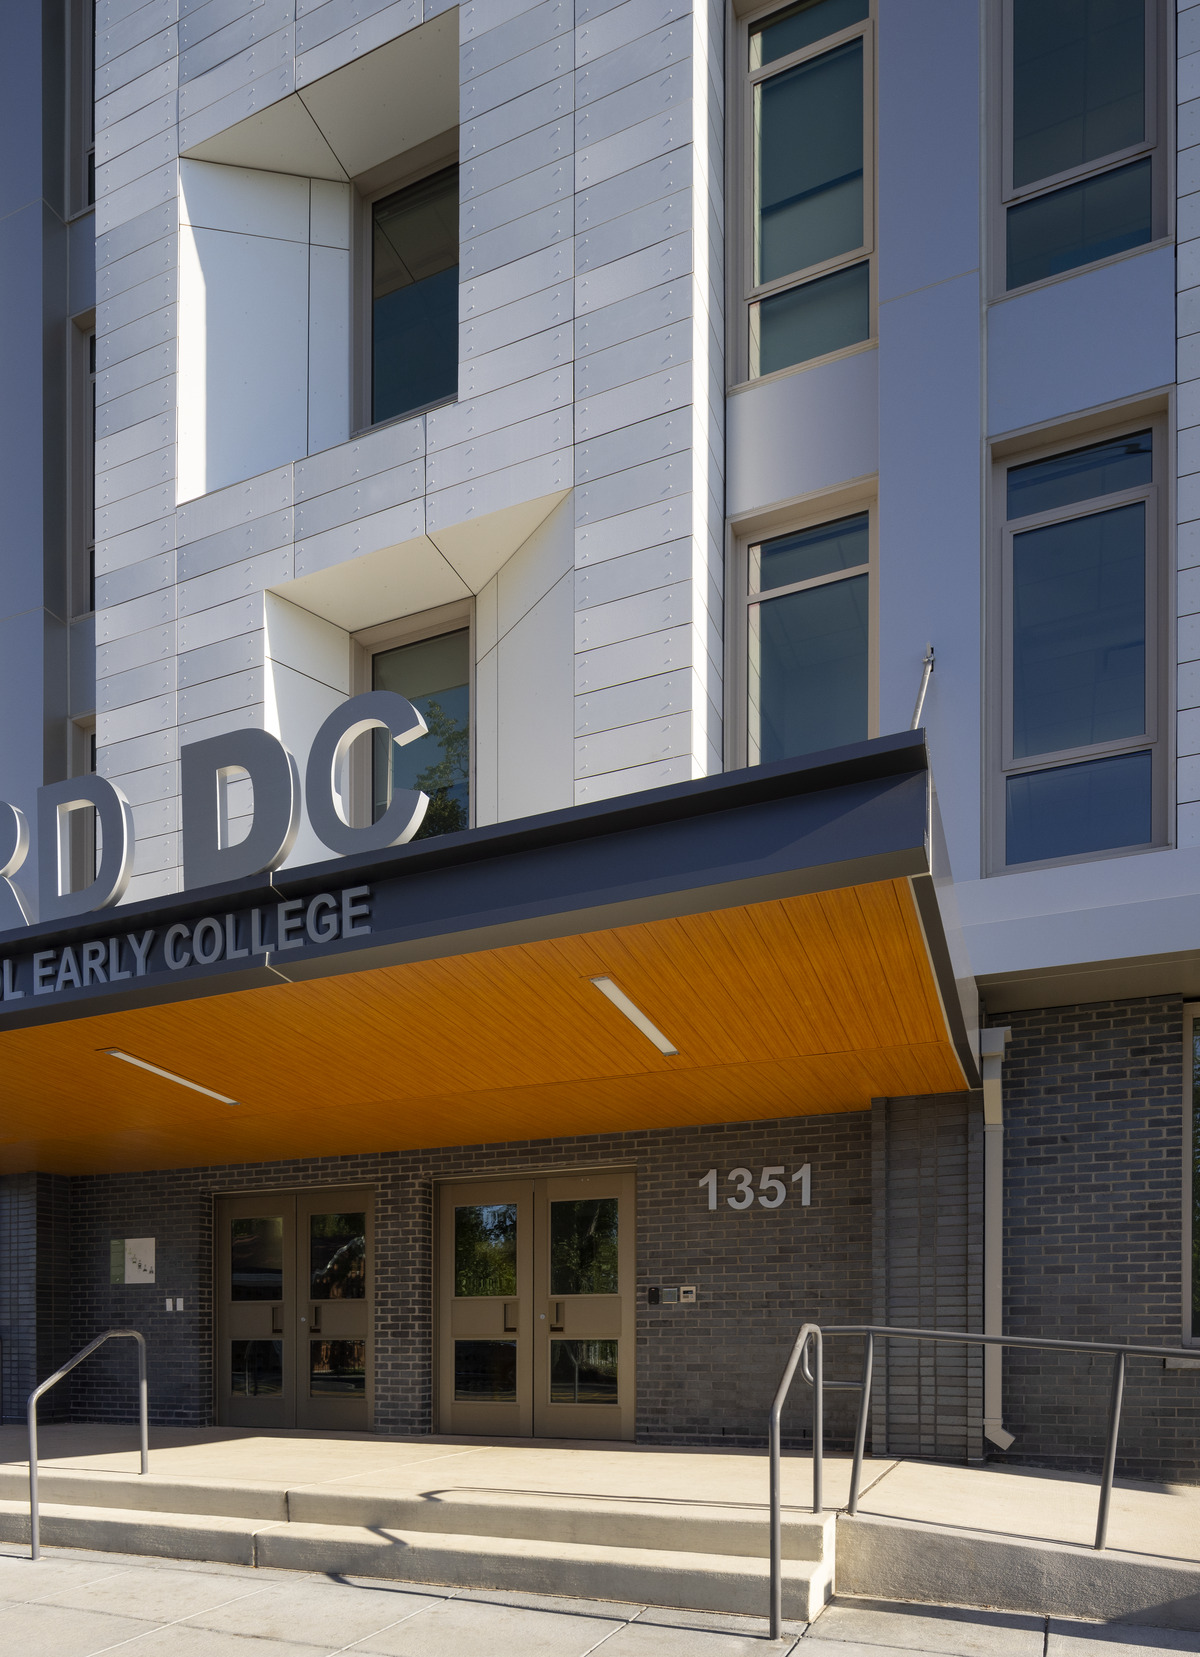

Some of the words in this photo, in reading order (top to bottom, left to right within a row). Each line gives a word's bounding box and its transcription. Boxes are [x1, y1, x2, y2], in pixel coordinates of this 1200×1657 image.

[181, 690, 430, 892] DC
[32, 929, 154, 995] EARLY
[163, 885, 371, 970] COLLEGE
[699, 1163, 811, 1210] 1351
